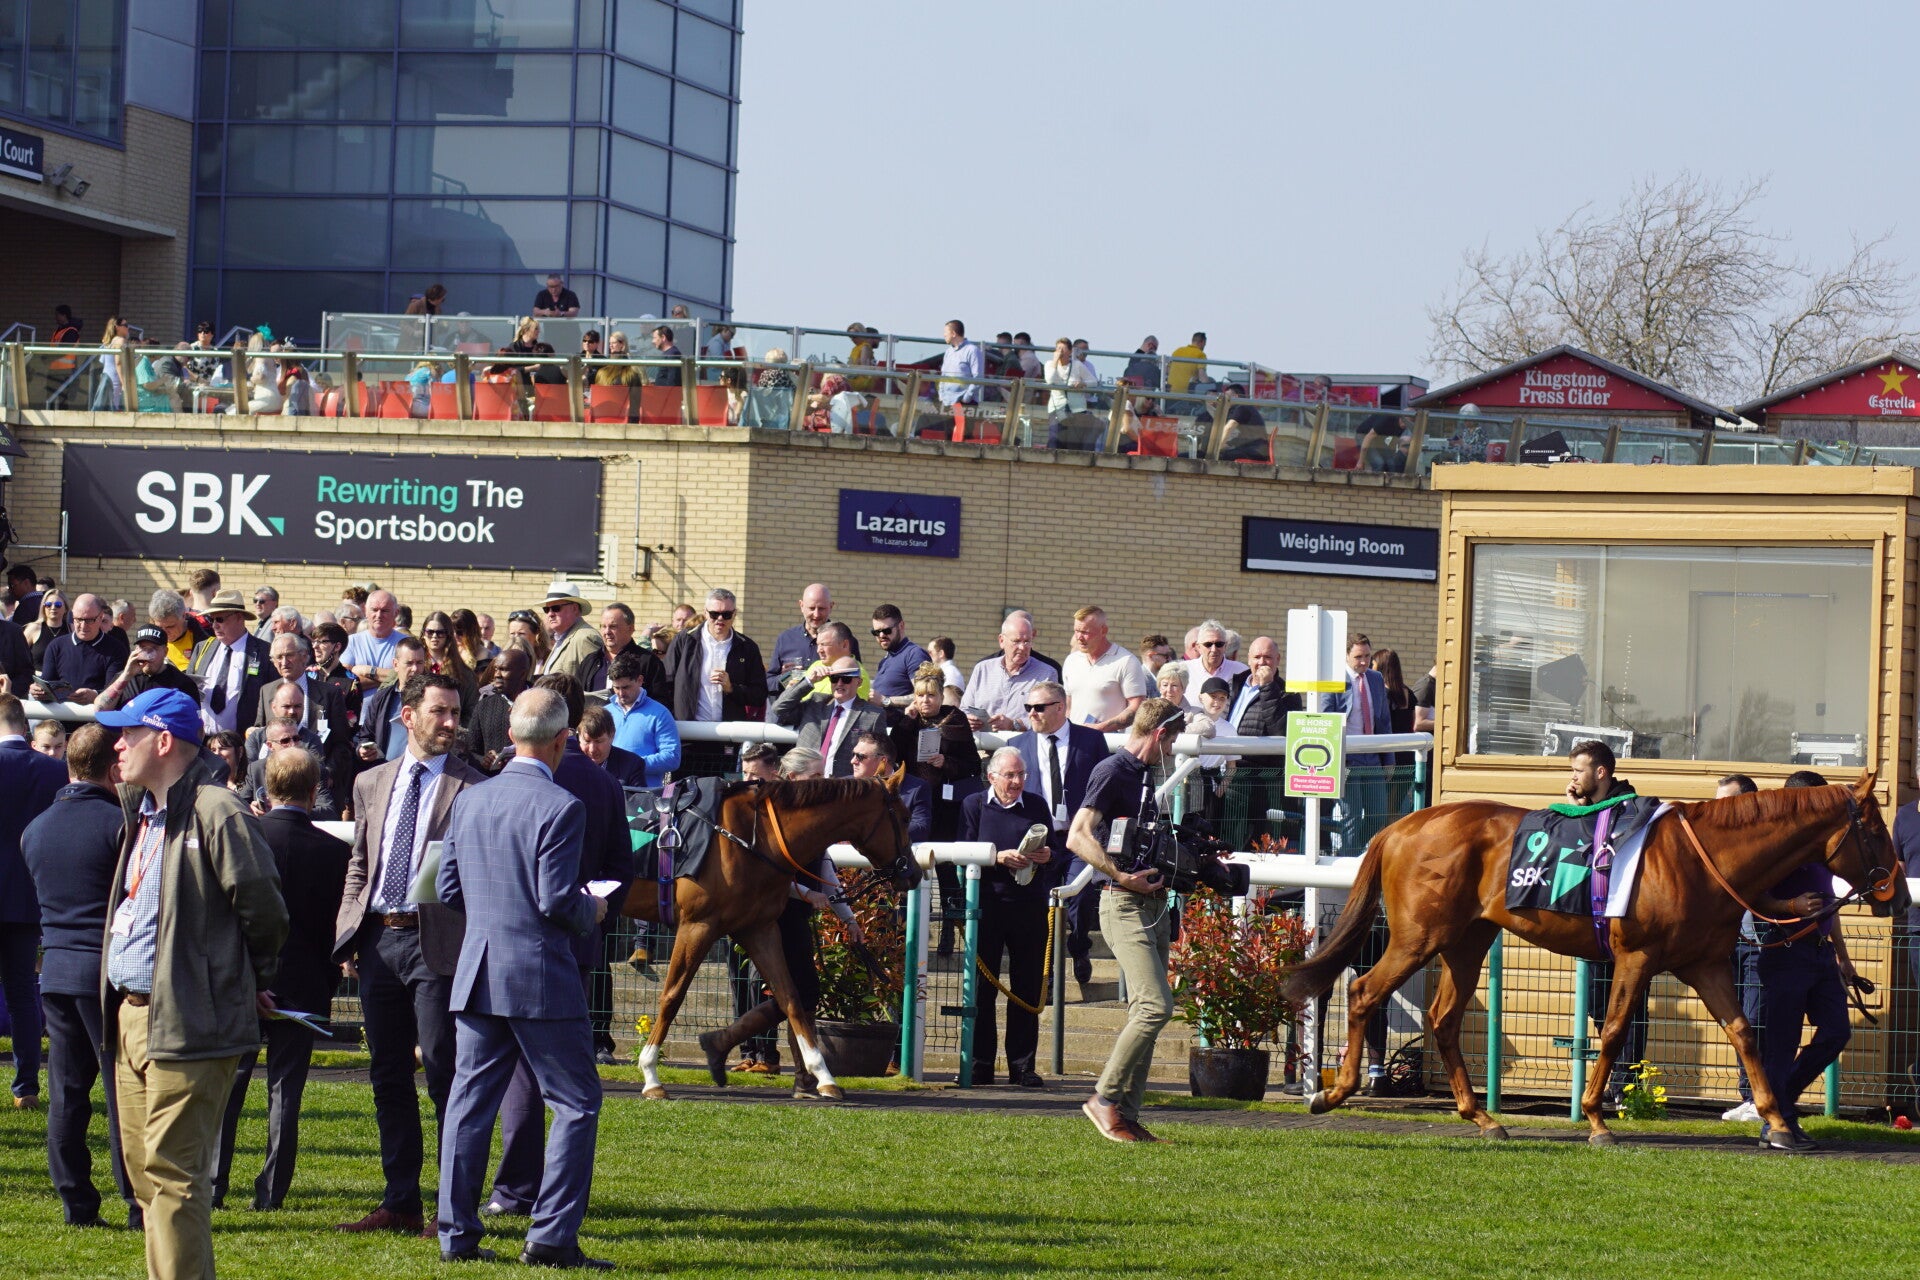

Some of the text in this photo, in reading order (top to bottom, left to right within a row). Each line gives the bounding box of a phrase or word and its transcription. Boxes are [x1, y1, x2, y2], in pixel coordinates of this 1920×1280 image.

[4, 138, 34, 166] Court
[1524, 369, 1607, 390] Kingstone
[1518, 387, 1611, 406] Press Cider
[1868, 394, 1915, 409] Estrella
[134, 470, 274, 537] SBK
[317, 475, 524, 513] Rewriting The
[314, 510, 495, 545] Sportsbook
[856, 510, 946, 536] Lazarus
[871, 536, 928, 547] The Lazarus Stand
[1279, 532, 1405, 556] Weighing Room
[137, 628, 161, 638] TWINZZ
[142, 715, 168, 730] Emirates
[1295, 718, 1333, 727] BE HORSE
[1300, 727, 1328, 735] AWARE
[1511, 866, 1550, 887] SBK
